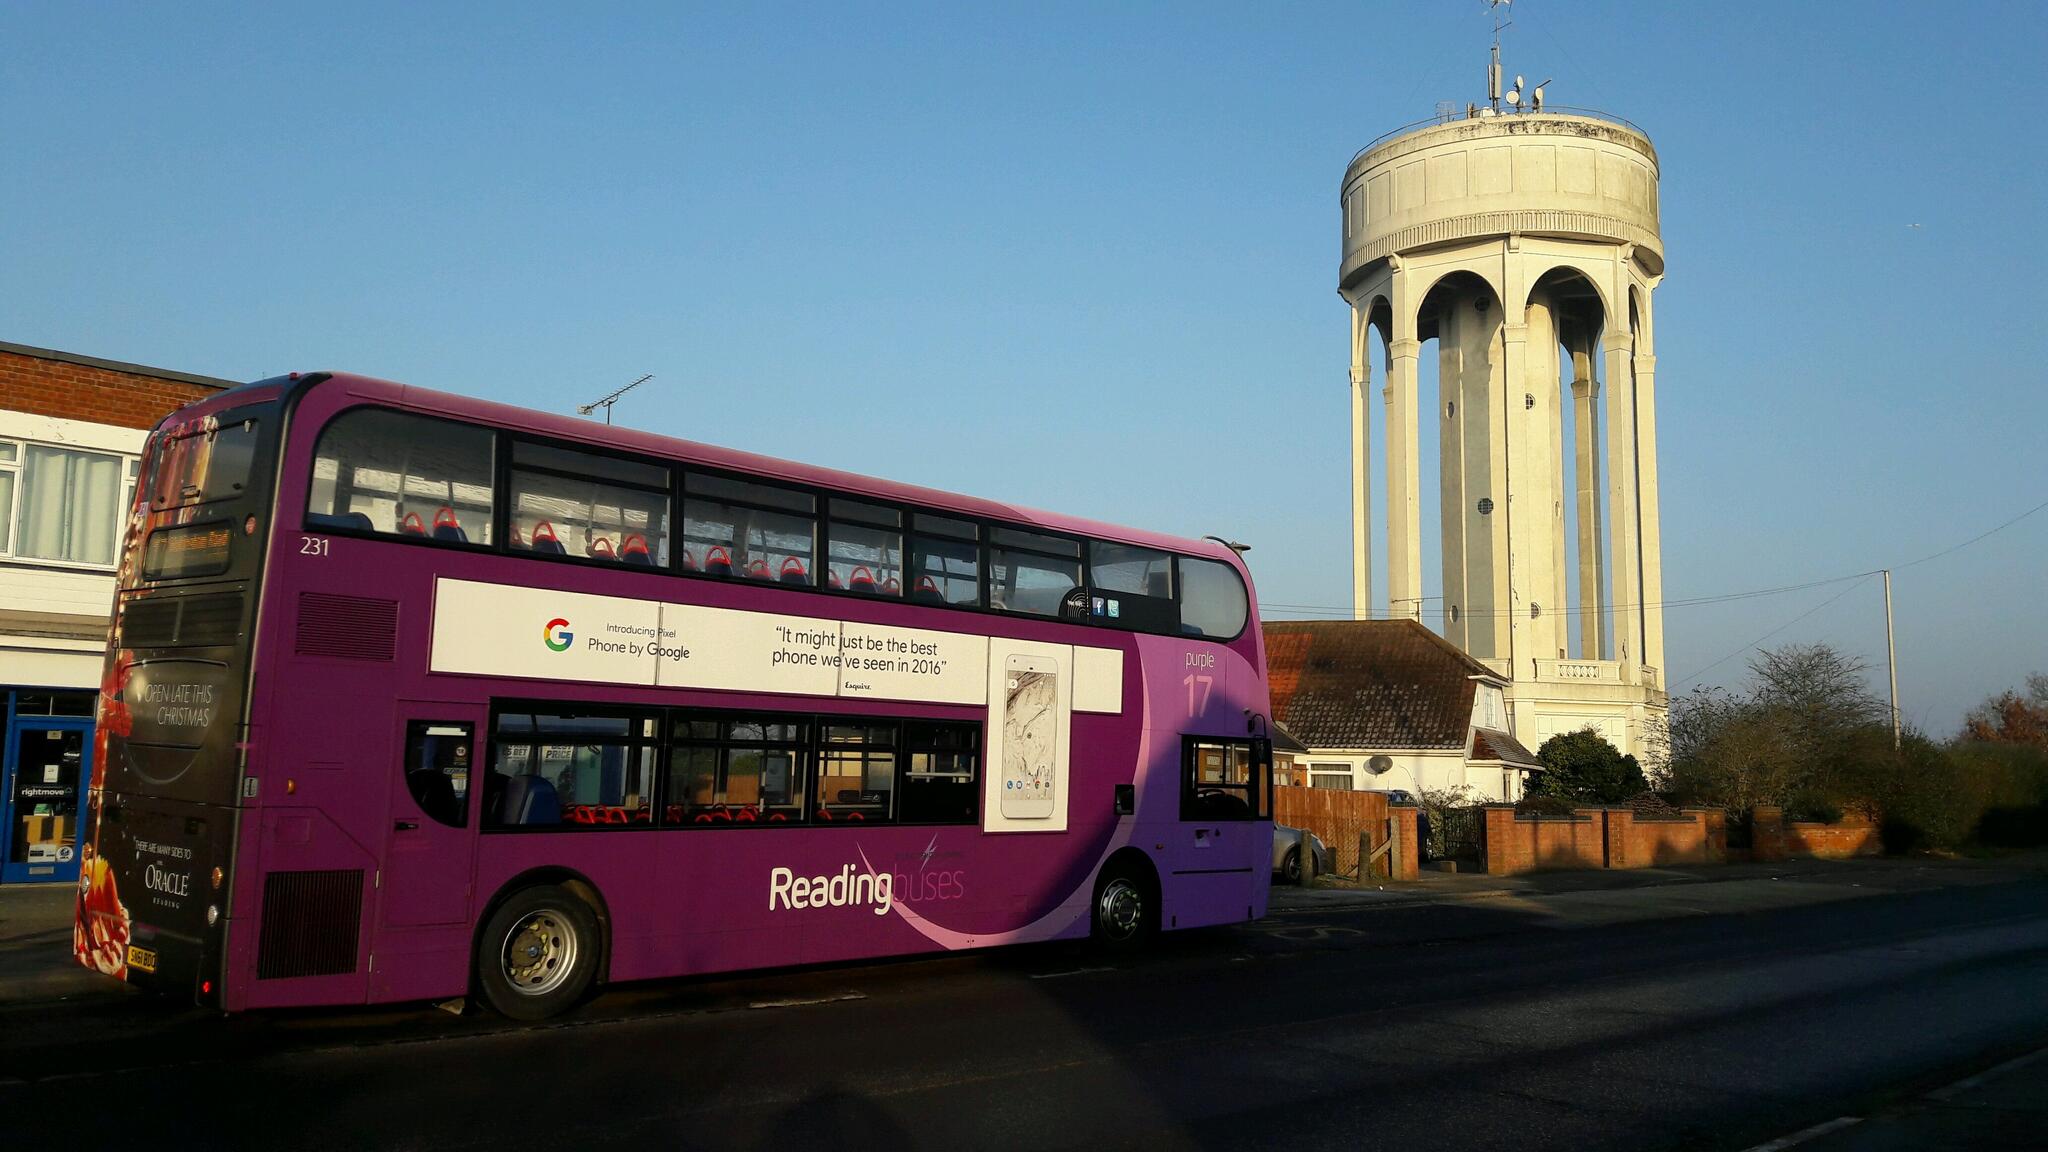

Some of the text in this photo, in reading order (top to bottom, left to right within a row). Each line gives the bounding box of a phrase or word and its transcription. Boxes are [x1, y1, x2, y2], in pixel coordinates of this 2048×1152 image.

[300, 536, 329, 556] 231
[606, 623, 677, 639] Introducing Pixel
[588, 638, 690, 662] Phone by Google
[795, 629, 836, 650] might
[838, 632, 863, 651] just
[866, 635, 883, 651] be
[886, 637, 908, 653] the
[910, 639, 938, 656] best
[772, 647, 818, 667] phone
[863, 657, 895, 672] seen
[897, 657, 909, 673] in
[1184, 650, 1216, 672] purple
[144, 684, 213, 704] OPEN LATE THIS
[1183, 673, 1214, 719] 17
[157, 706, 210, 727] CHRISTMAS
[545, 750, 572, 759] PRICE
[21, 788, 65, 797] rightmove
[145, 864, 190, 897] ORACLE
[769, 863, 965, 916] Reading buses
